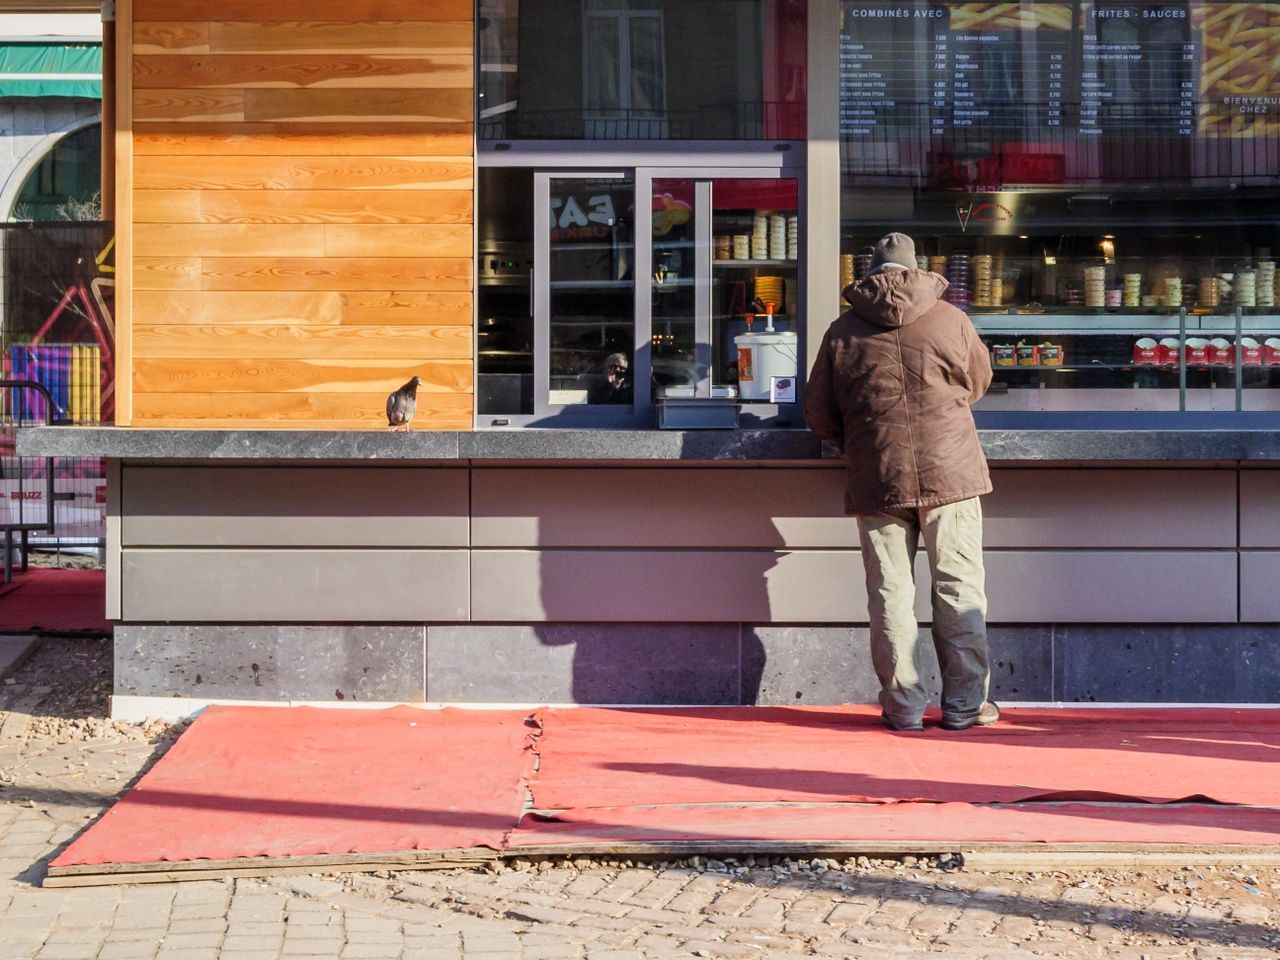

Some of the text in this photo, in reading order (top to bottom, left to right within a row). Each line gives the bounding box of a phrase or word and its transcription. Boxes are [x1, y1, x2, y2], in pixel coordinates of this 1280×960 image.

[852, 7, 943, 18] COMBINÉS AVEC
[1091, 9, 1130, 19] FRITES
[1142, 9, 1186, 19] SAUCES
